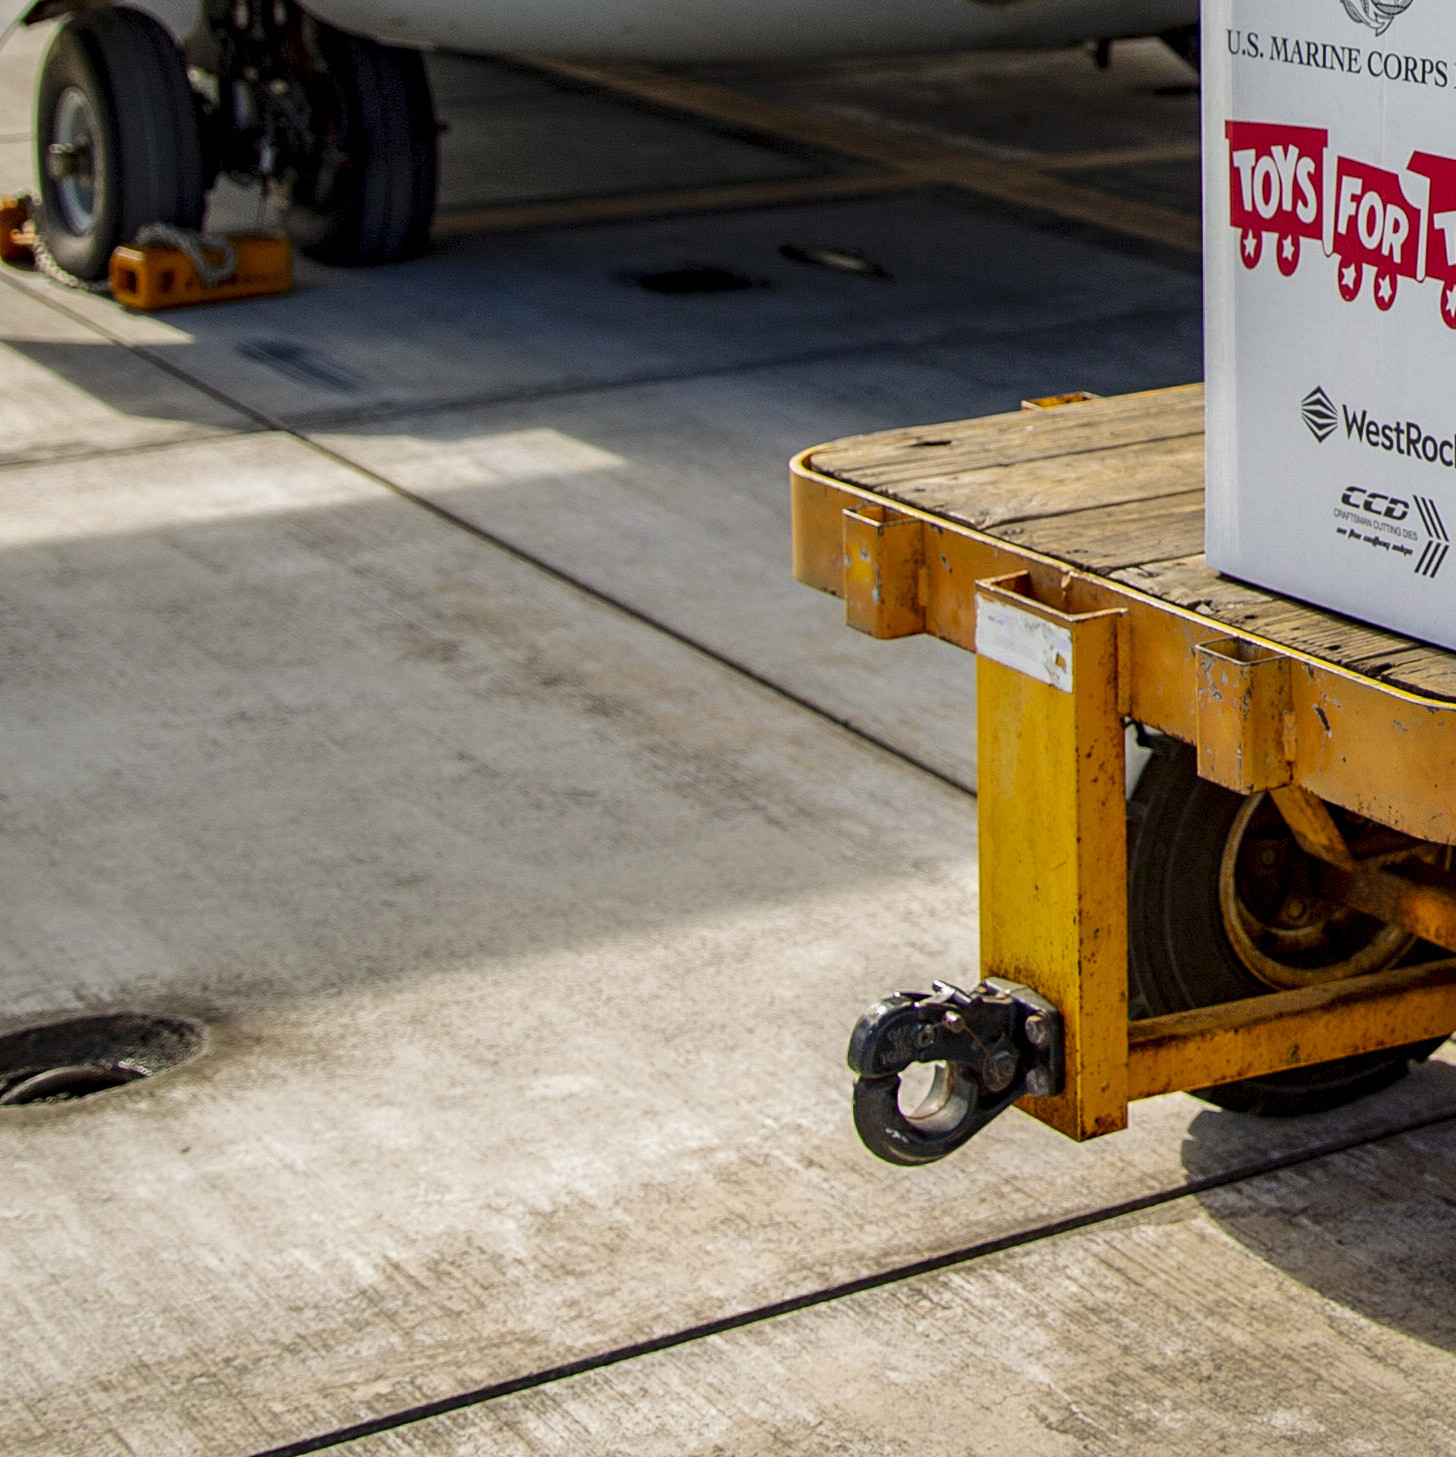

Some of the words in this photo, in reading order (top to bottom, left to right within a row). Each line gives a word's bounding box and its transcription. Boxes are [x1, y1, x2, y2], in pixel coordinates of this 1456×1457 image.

[1225, 29, 1265, 58] U.S.
[1269, 36, 1362, 74] MARINE
[1367, 50, 1448, 87] CORPS
[1232, 143, 1317, 224] TOYS
[1337, 175, 1409, 264] FOR
[1333, 507, 1372, 528] CRAFTSMAN
[1373, 519, 1401, 537] CUTTING
[1402, 527, 1418, 542] DIES
[1341, 486, 1410, 521] CCD
